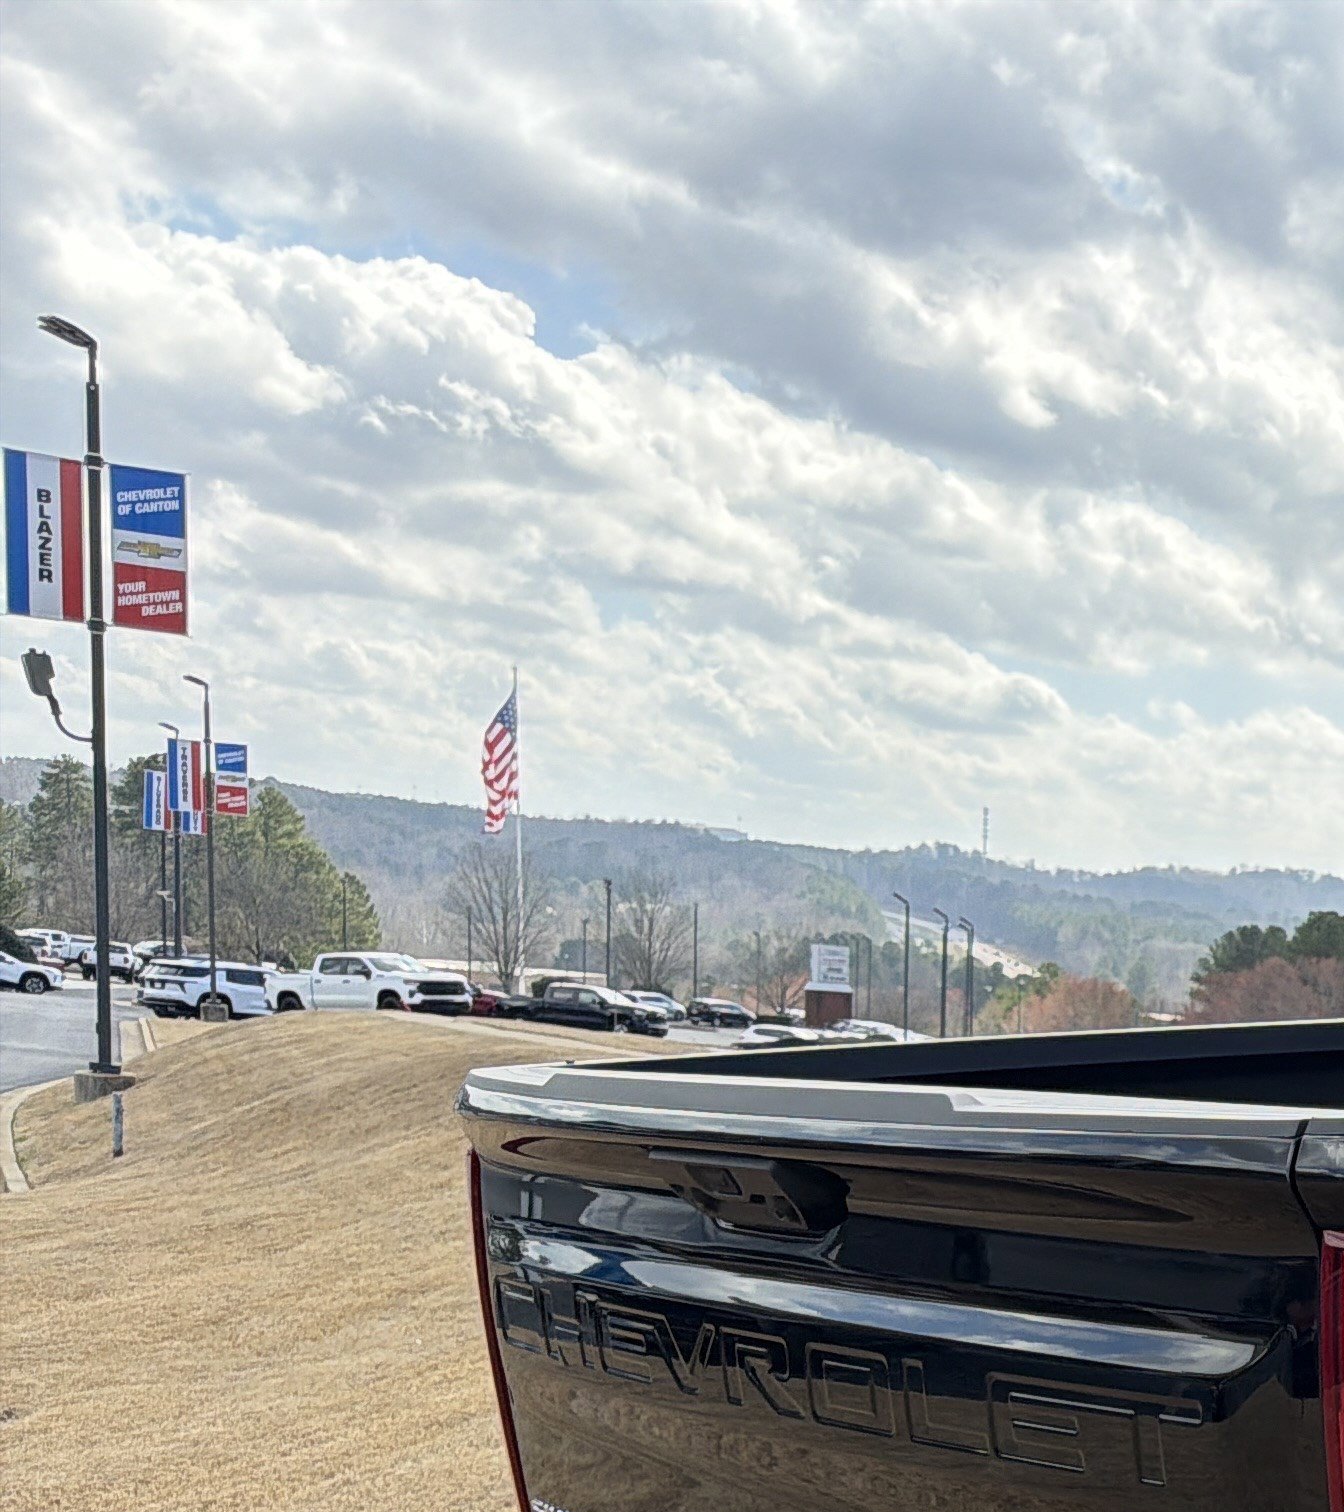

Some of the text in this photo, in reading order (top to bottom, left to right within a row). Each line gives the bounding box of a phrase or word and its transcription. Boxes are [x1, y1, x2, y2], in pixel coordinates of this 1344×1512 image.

[116, 486, 180, 503] CHEVROLET
[117, 500, 180, 516] OF CANTON
[36, 488, 53, 583] BLAZER
[117, 581, 146, 594] YOUR
[117, 589, 180, 606] HOMETOWN
[141, 602, 183, 617] DEALER
[495, 1273, 1203, 1487] CHEVROLET
